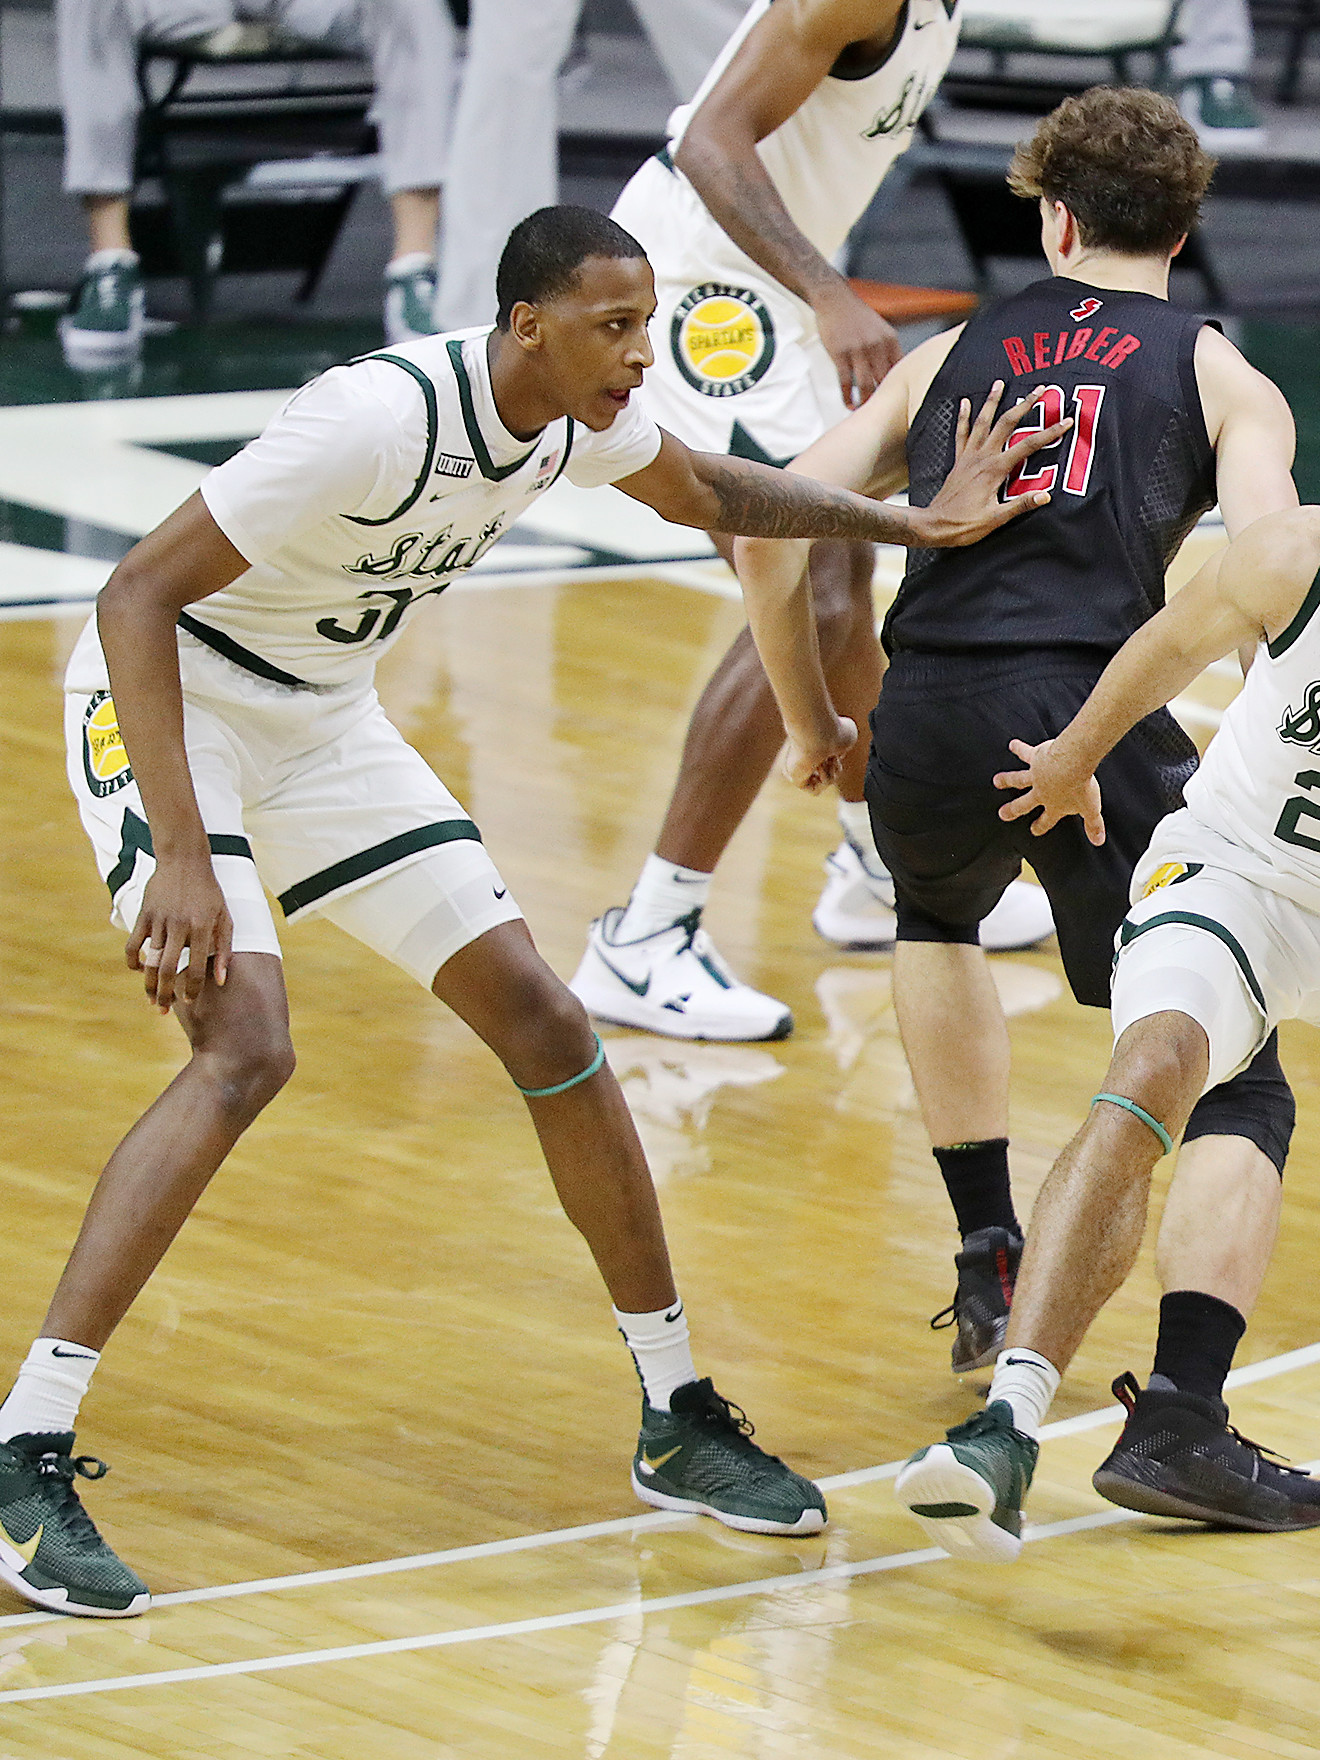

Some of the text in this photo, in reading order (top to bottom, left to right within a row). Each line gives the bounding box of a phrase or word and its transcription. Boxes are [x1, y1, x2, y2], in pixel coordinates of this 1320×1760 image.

[1003, 327, 1141, 376] REIBER
[438, 455, 473, 477] UNITY
[1003, 384, 1106, 502] 21
[342, 510, 505, 582] Stat
[99, 771, 129, 797] STAT
